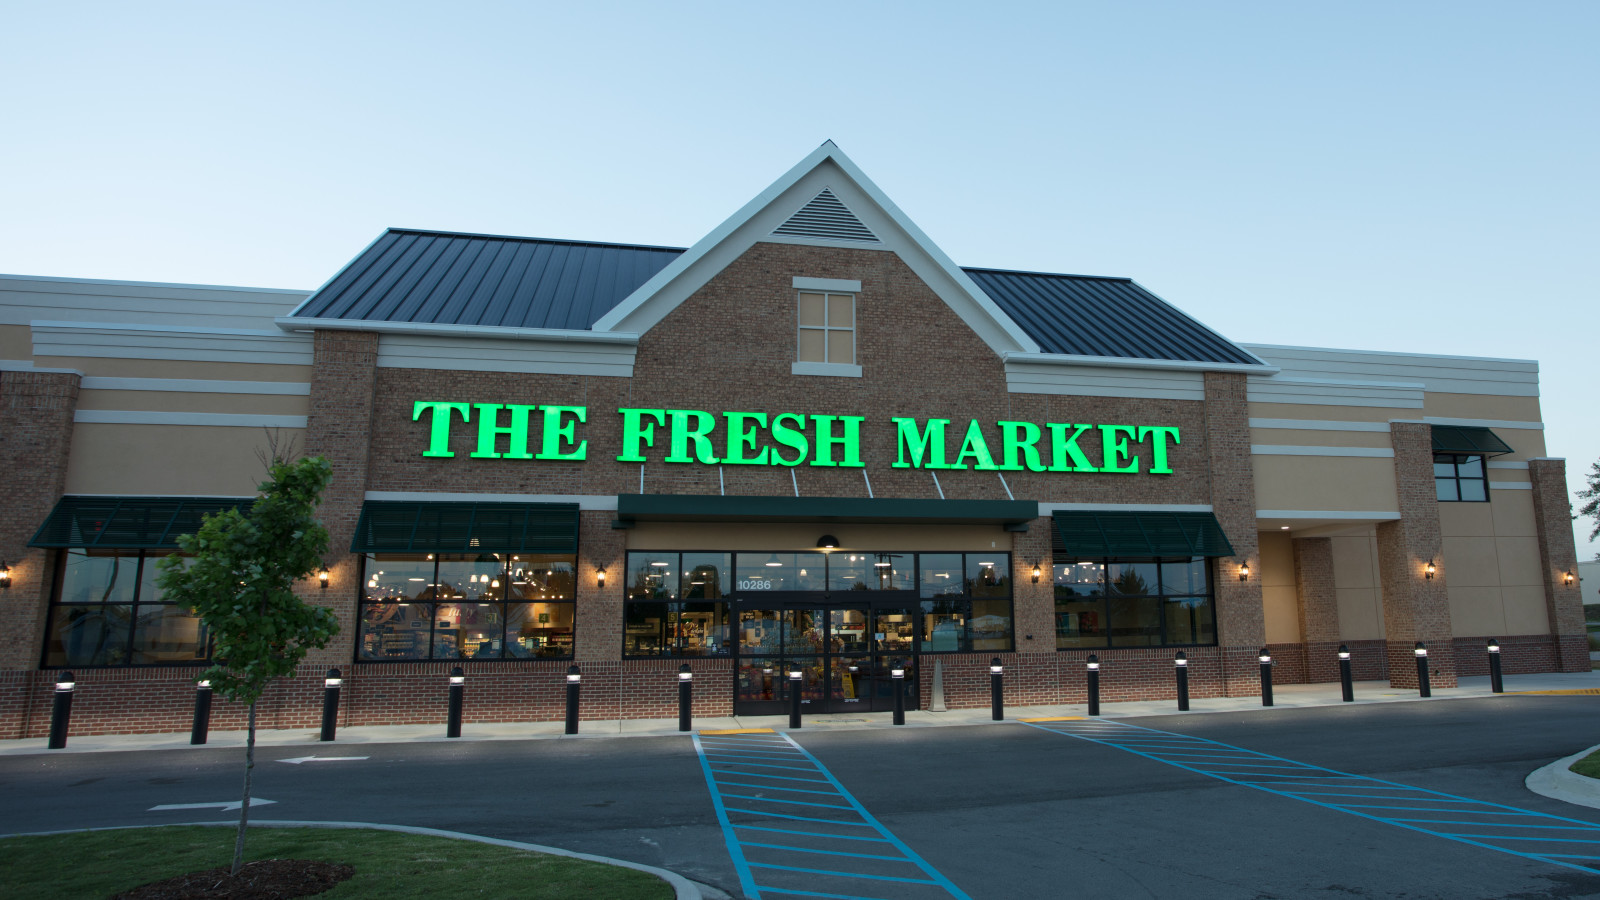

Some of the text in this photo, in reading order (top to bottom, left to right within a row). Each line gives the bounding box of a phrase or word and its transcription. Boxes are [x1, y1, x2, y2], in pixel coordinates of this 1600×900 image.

[412, 401, 1181, 474] THE FRESH MARKET
[739, 580, 771, 590] 10286
